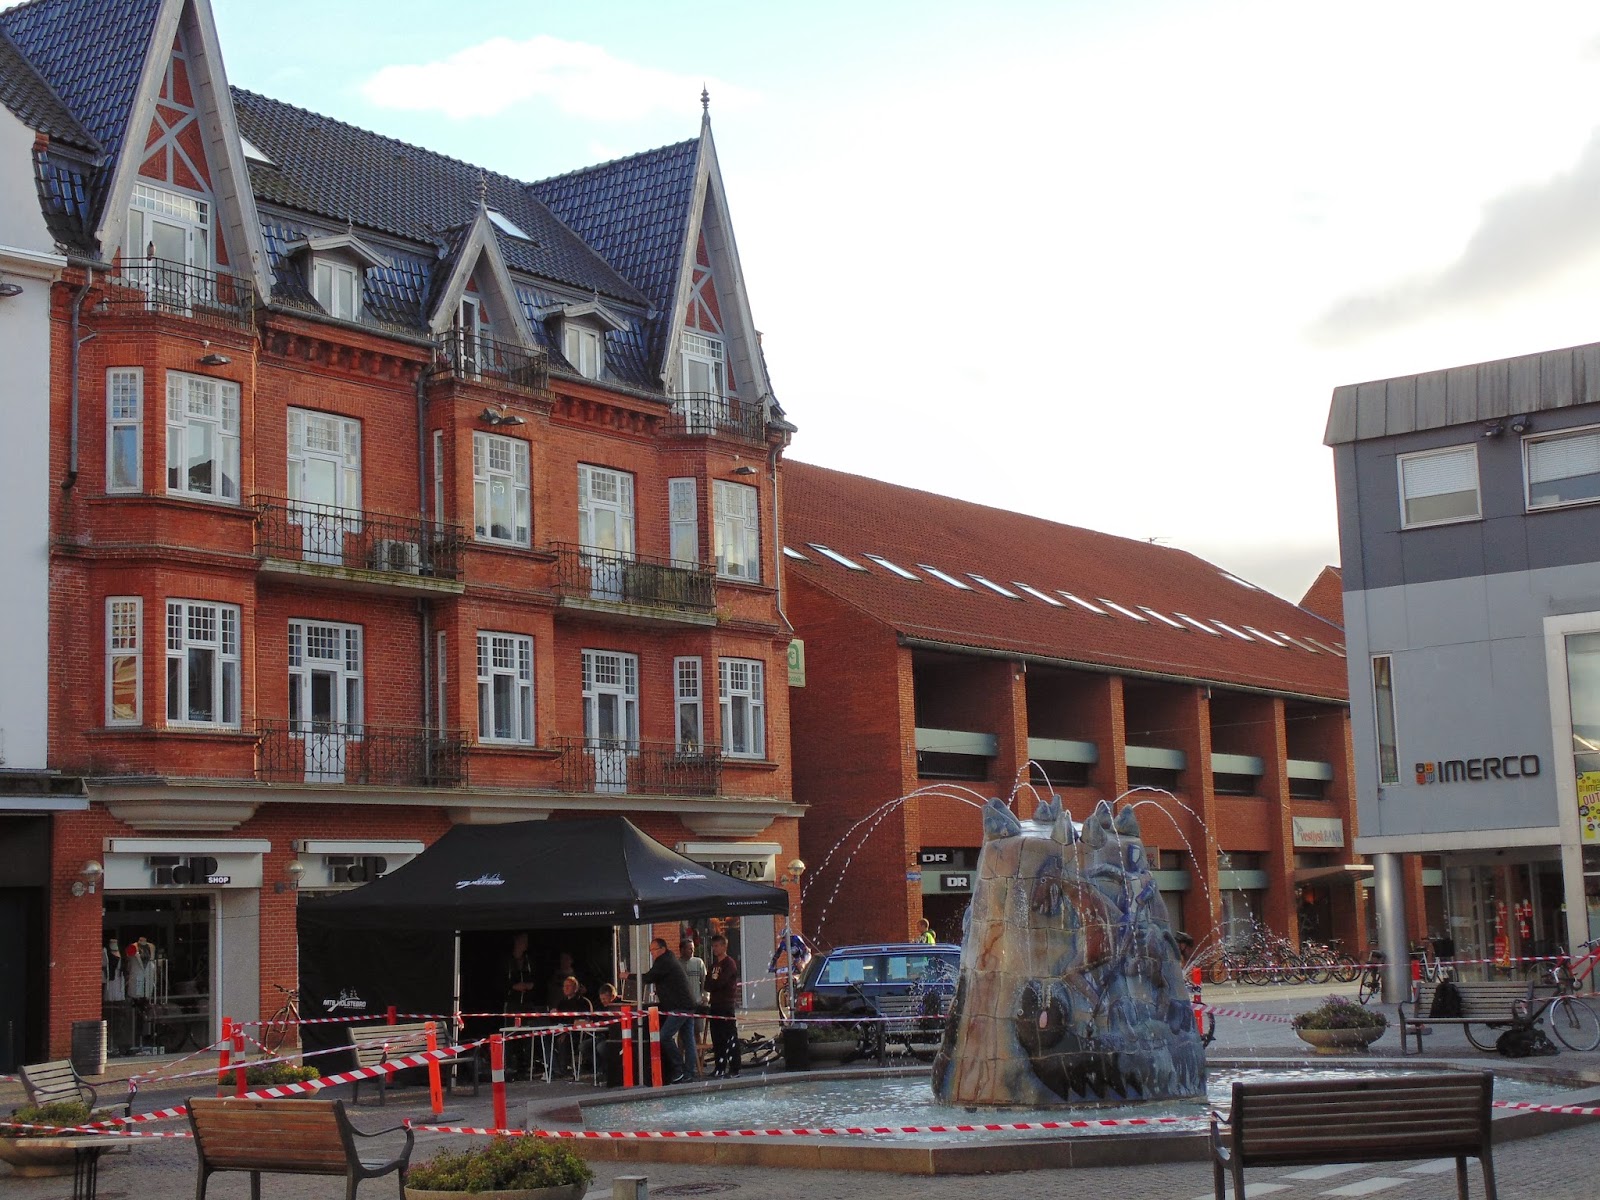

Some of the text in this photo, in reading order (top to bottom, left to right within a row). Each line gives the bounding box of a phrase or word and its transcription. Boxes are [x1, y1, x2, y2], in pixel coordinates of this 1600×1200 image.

[1437, 755, 1540, 783] IMERCO
[922, 853, 948, 863] DR
[208, 876, 229, 884] SHOP
[946, 877, 967, 887] DR
